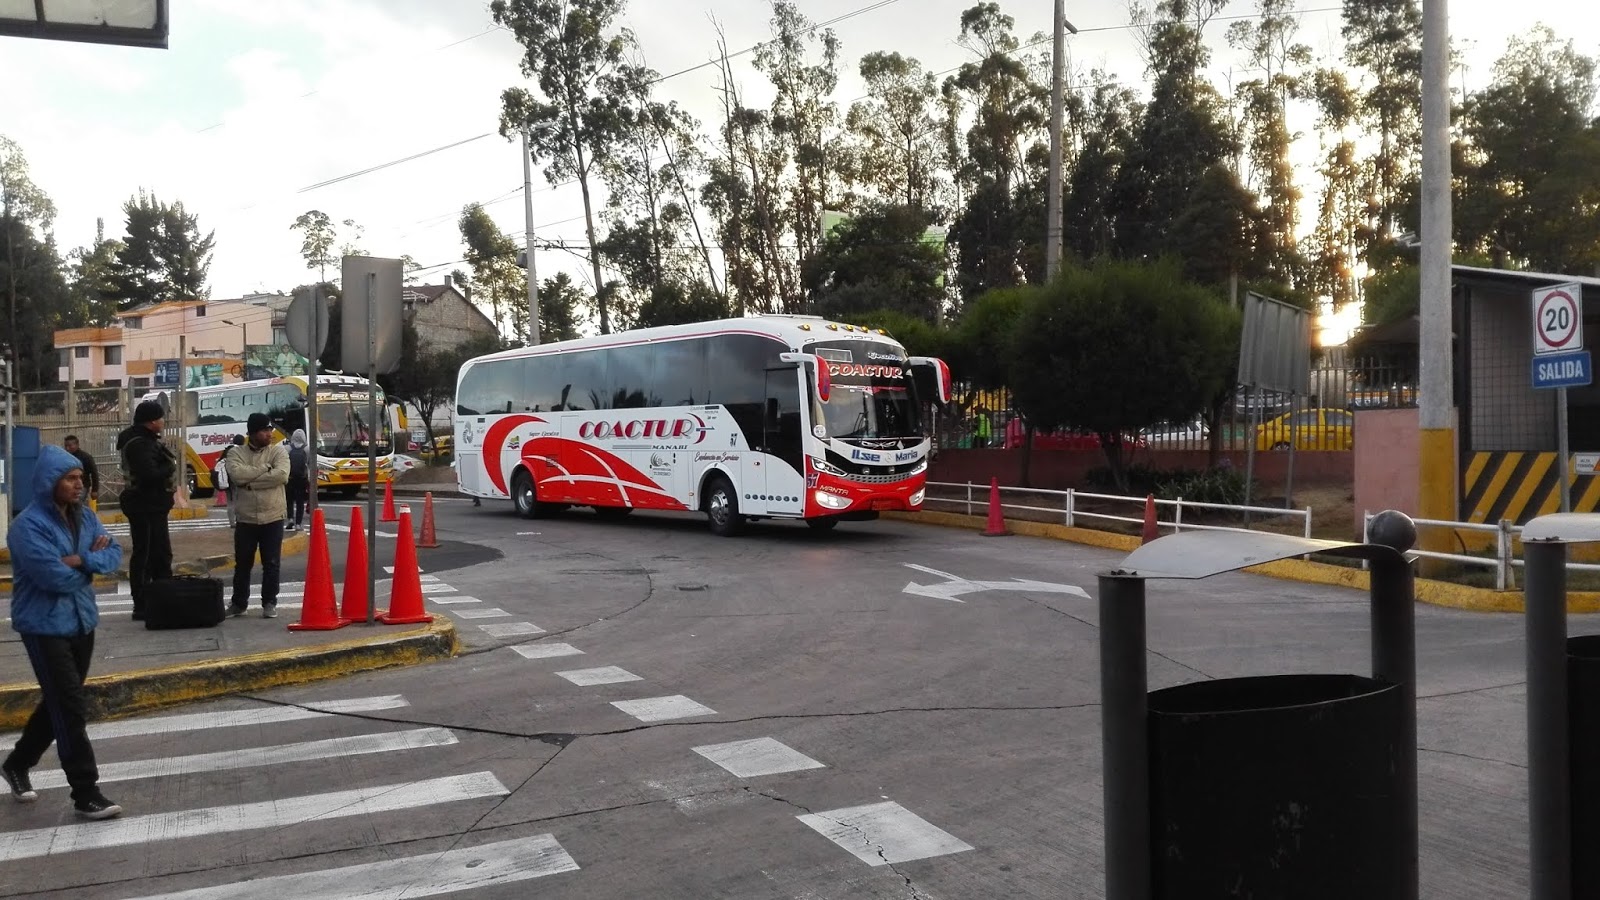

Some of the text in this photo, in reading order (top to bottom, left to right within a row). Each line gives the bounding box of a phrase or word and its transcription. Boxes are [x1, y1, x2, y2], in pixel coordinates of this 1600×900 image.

[1545, 306, 1569, 332] 20
[829, 363, 904, 379] COACTUR
[1538, 360, 1584, 381] SALIDA
[579, 418, 694, 440] COACTUR
[819, 485, 849, 495] MANTA
